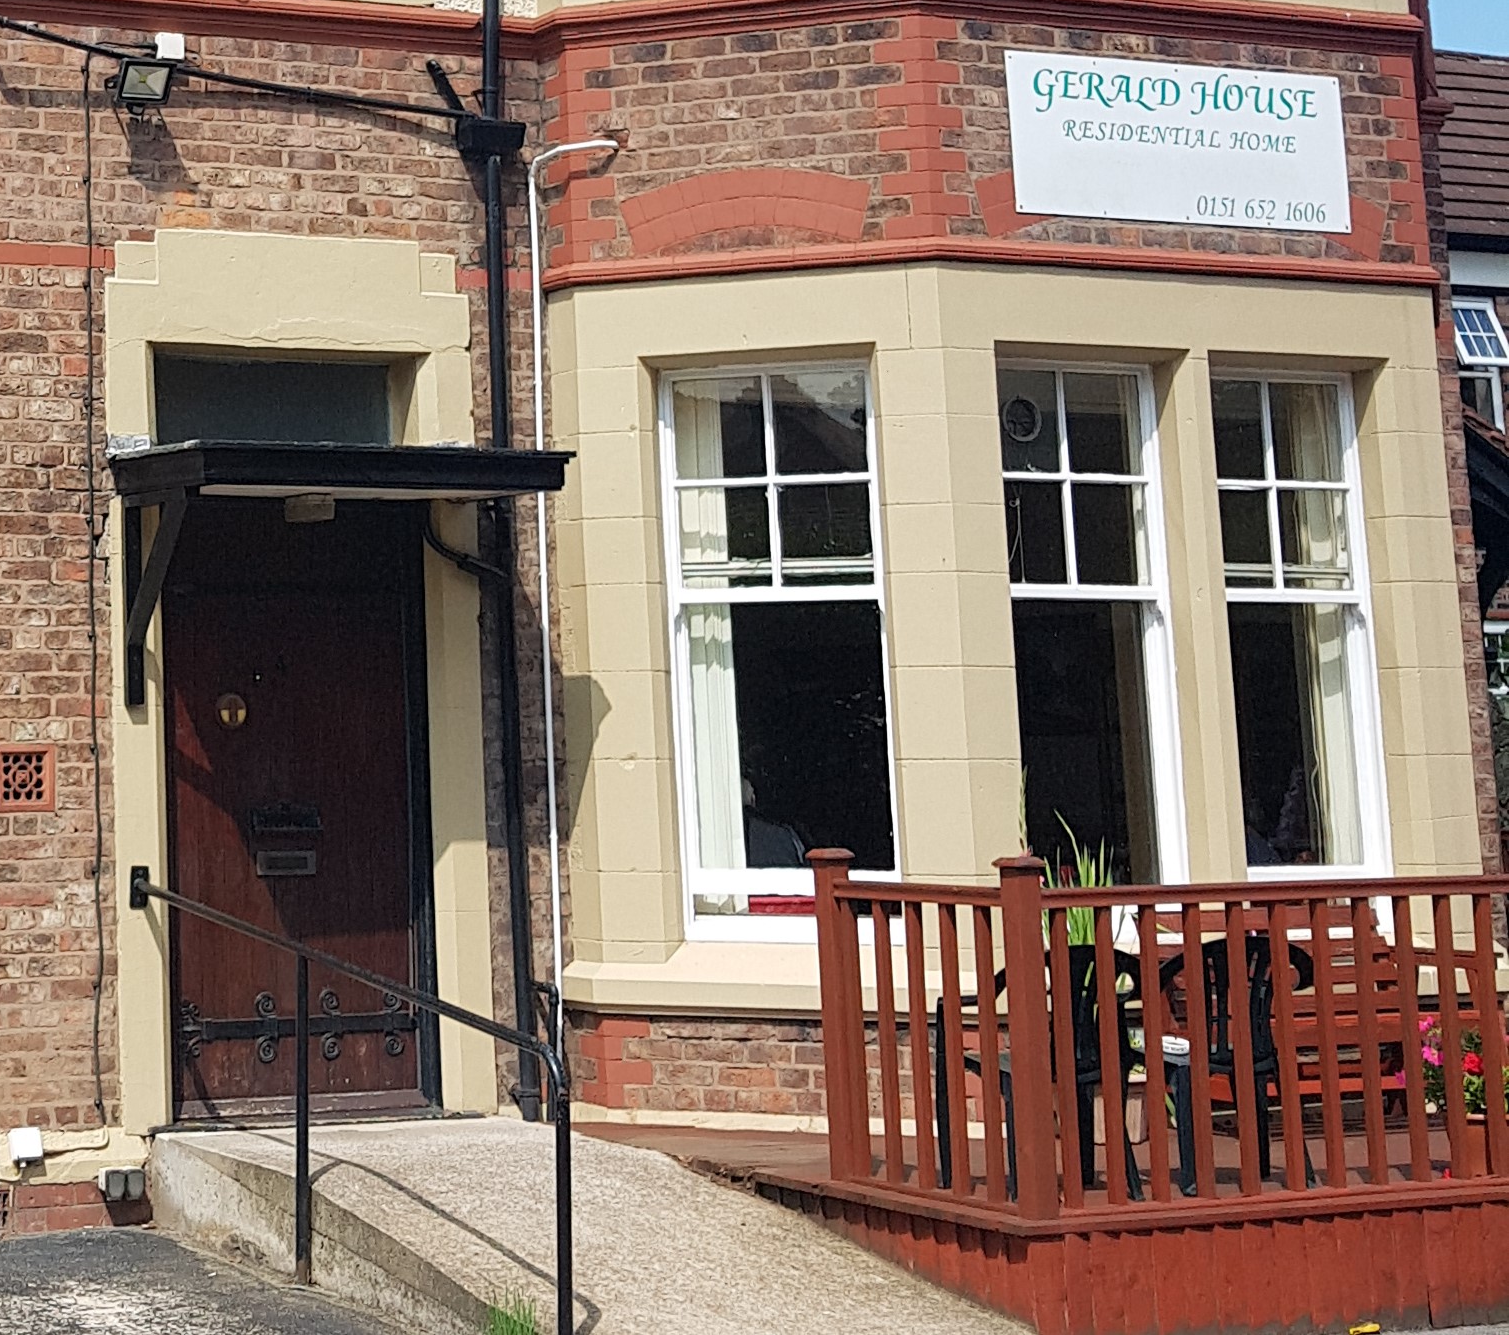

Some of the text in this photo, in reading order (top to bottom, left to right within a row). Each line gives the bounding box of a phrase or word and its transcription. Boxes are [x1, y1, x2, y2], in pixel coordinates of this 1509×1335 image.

[1032, 68, 1318, 120] GERALD HOUSE
[1062, 119, 1297, 154] RESIDENTIAL HOME
[1196, 195, 1326, 223] 0151 652 1606
